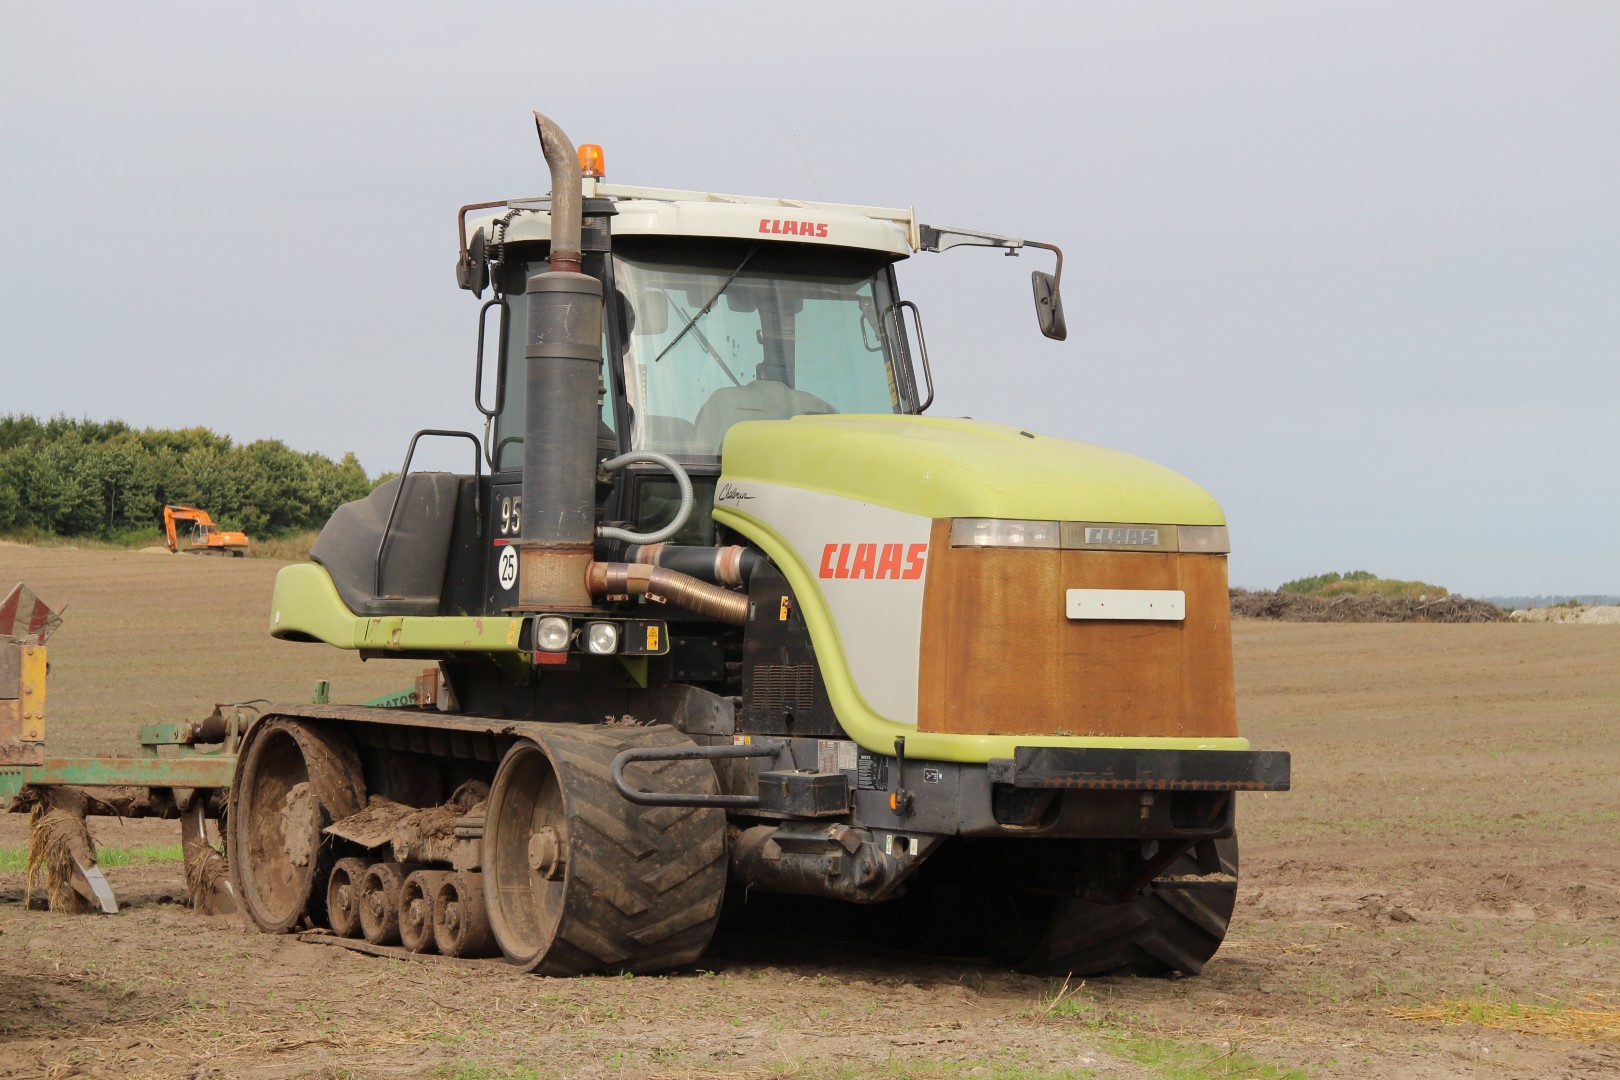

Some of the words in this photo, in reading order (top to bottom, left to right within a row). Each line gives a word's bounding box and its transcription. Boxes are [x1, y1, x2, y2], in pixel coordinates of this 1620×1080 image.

[759, 218, 828, 237] CLAAS
[1088, 528, 1156, 545] CLAAS
[502, 554, 514, 581] 25
[819, 543, 928, 580] CLAAS
